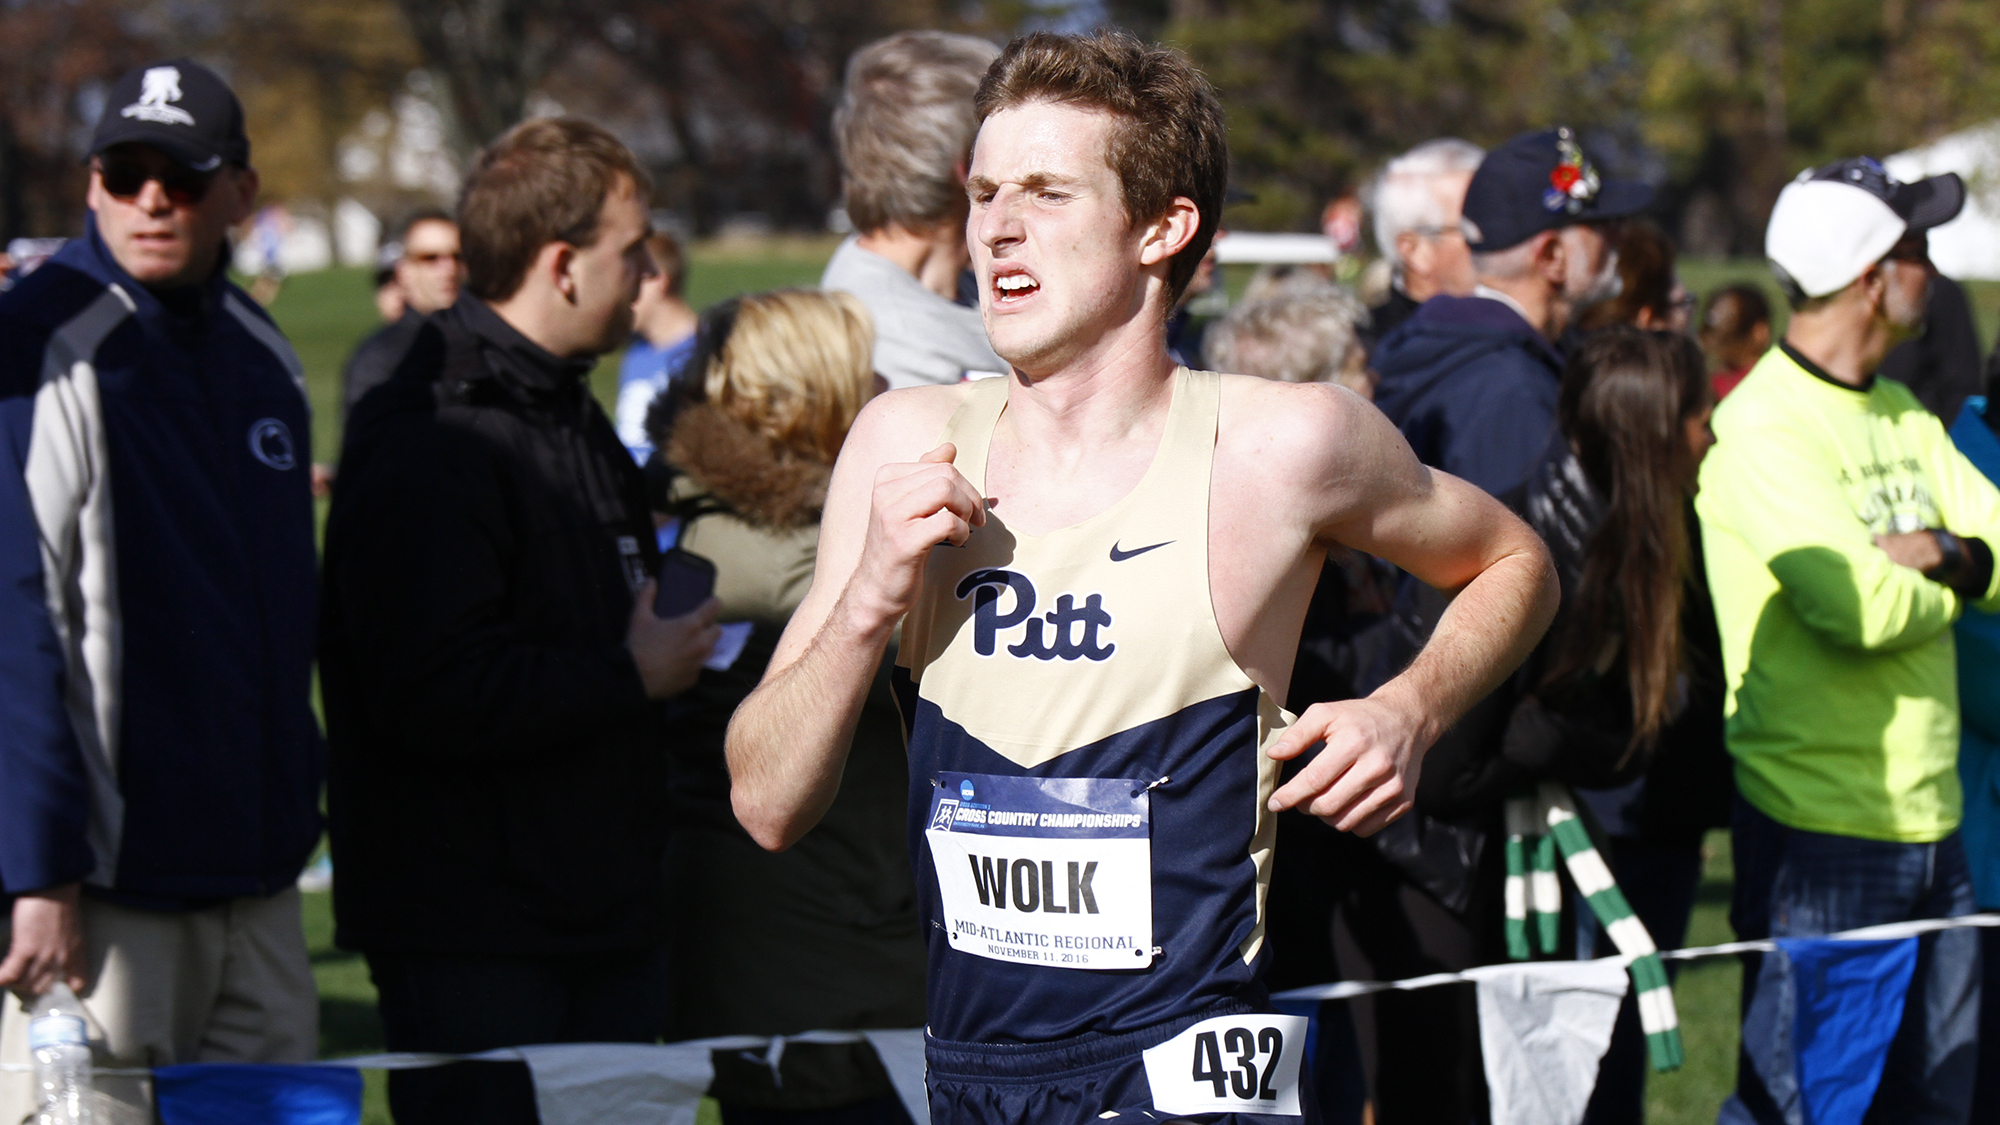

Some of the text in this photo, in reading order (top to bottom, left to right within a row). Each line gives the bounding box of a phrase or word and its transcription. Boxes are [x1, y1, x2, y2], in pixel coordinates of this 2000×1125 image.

[954, 567, 1118, 664] Pitt
[954, 807, 987, 824] CROSS
[987, 810, 1039, 827] COUNTRY
[1039, 813, 1141, 828] CHAMPIONSHIPS
[968, 853, 1100, 914] WOLK
[954, 918, 1138, 950] MID-ATLANTIC REGIONAL
[987, 944, 1089, 964] NOVEMBER 11, 2016
[1192, 1026, 1284, 1101] 432
